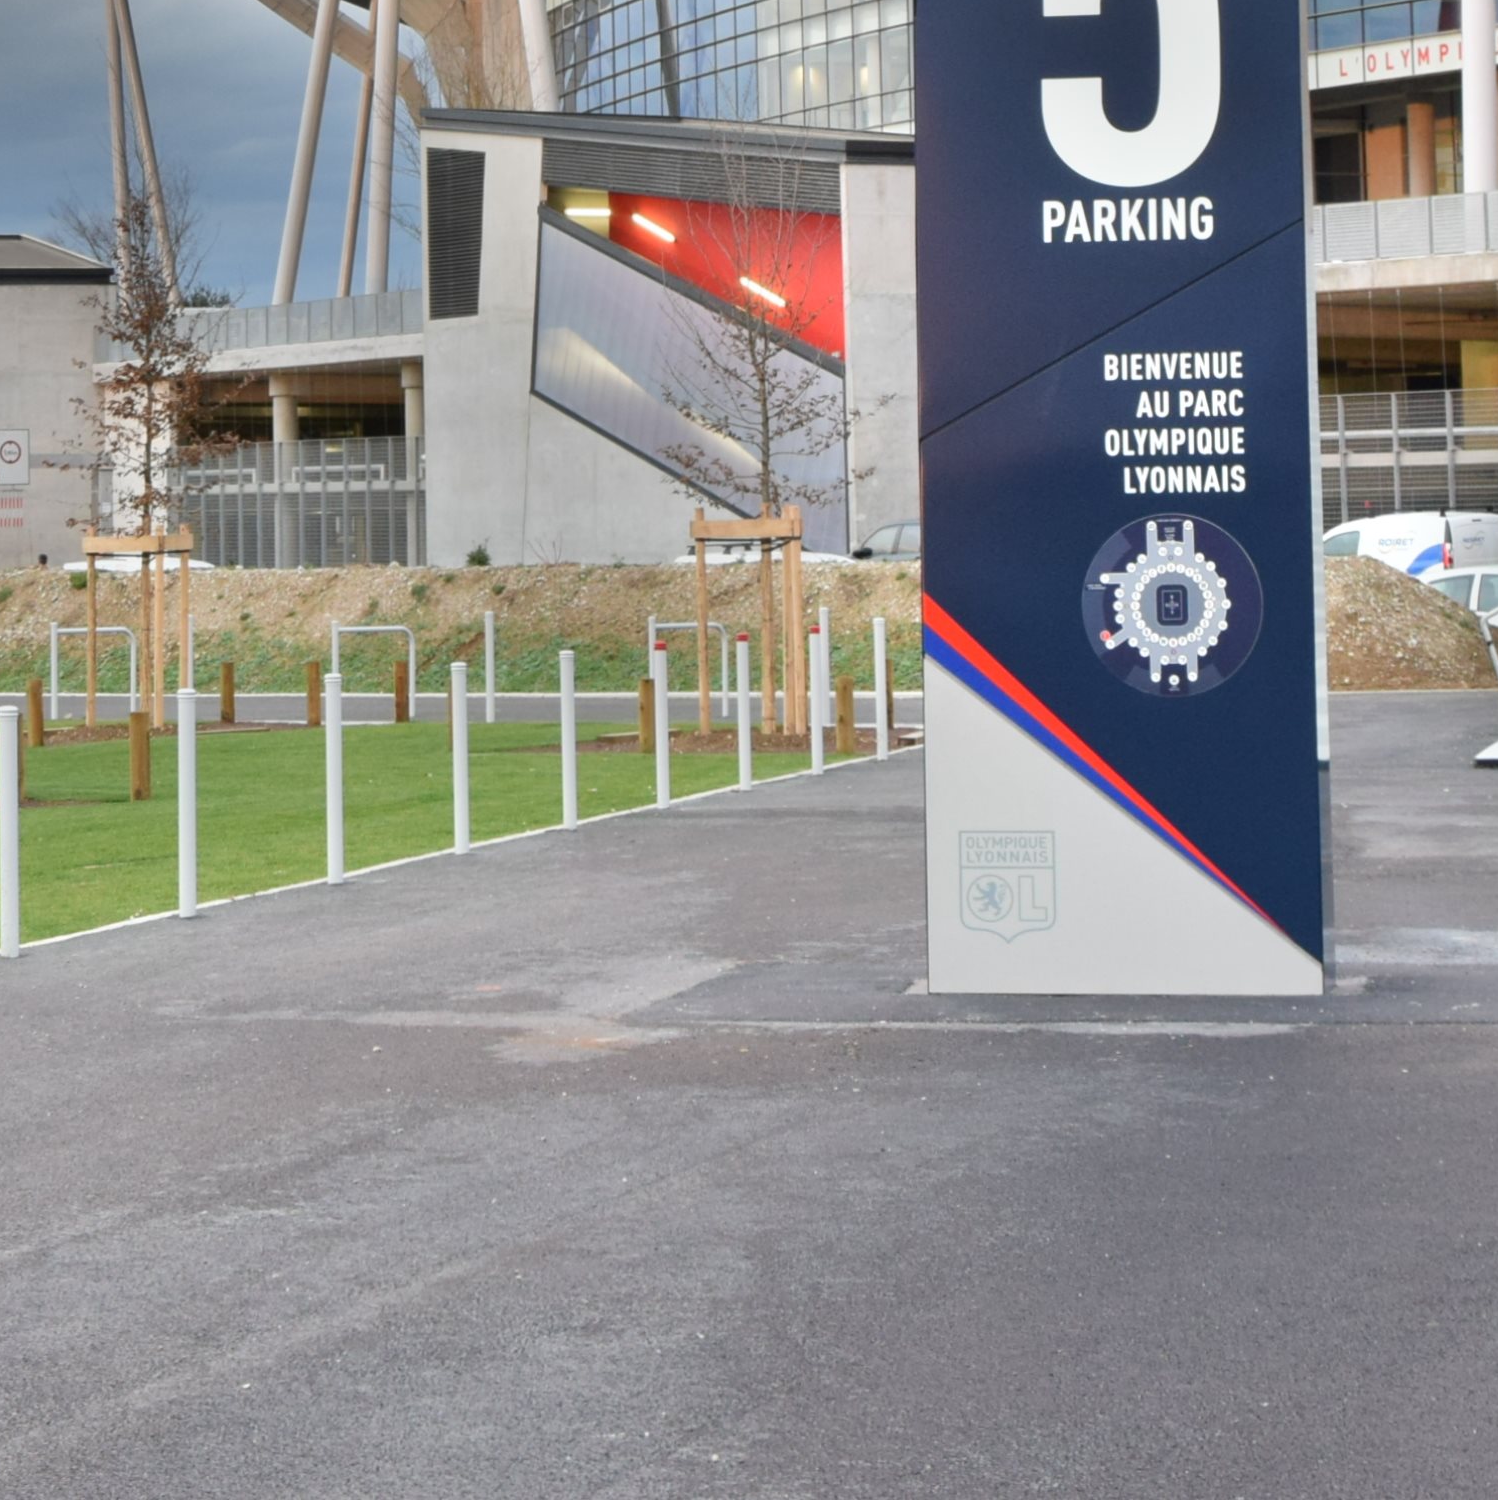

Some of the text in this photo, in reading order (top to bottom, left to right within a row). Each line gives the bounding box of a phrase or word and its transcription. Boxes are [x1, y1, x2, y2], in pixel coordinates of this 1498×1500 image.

[1042, 196, 1214, 244] PARKING
[1103, 350, 1244, 382] BIENVENUE
[1135, 388, 1245, 418] AU PARC
[1104, 426, 1246, 457] OLYMPIQUE
[1123, 464, 1246, 495] LYONNAIS
[965, 835, 1049, 850] OLYMPIQUE
[966, 850, 1048, 864] LYONNAIS
